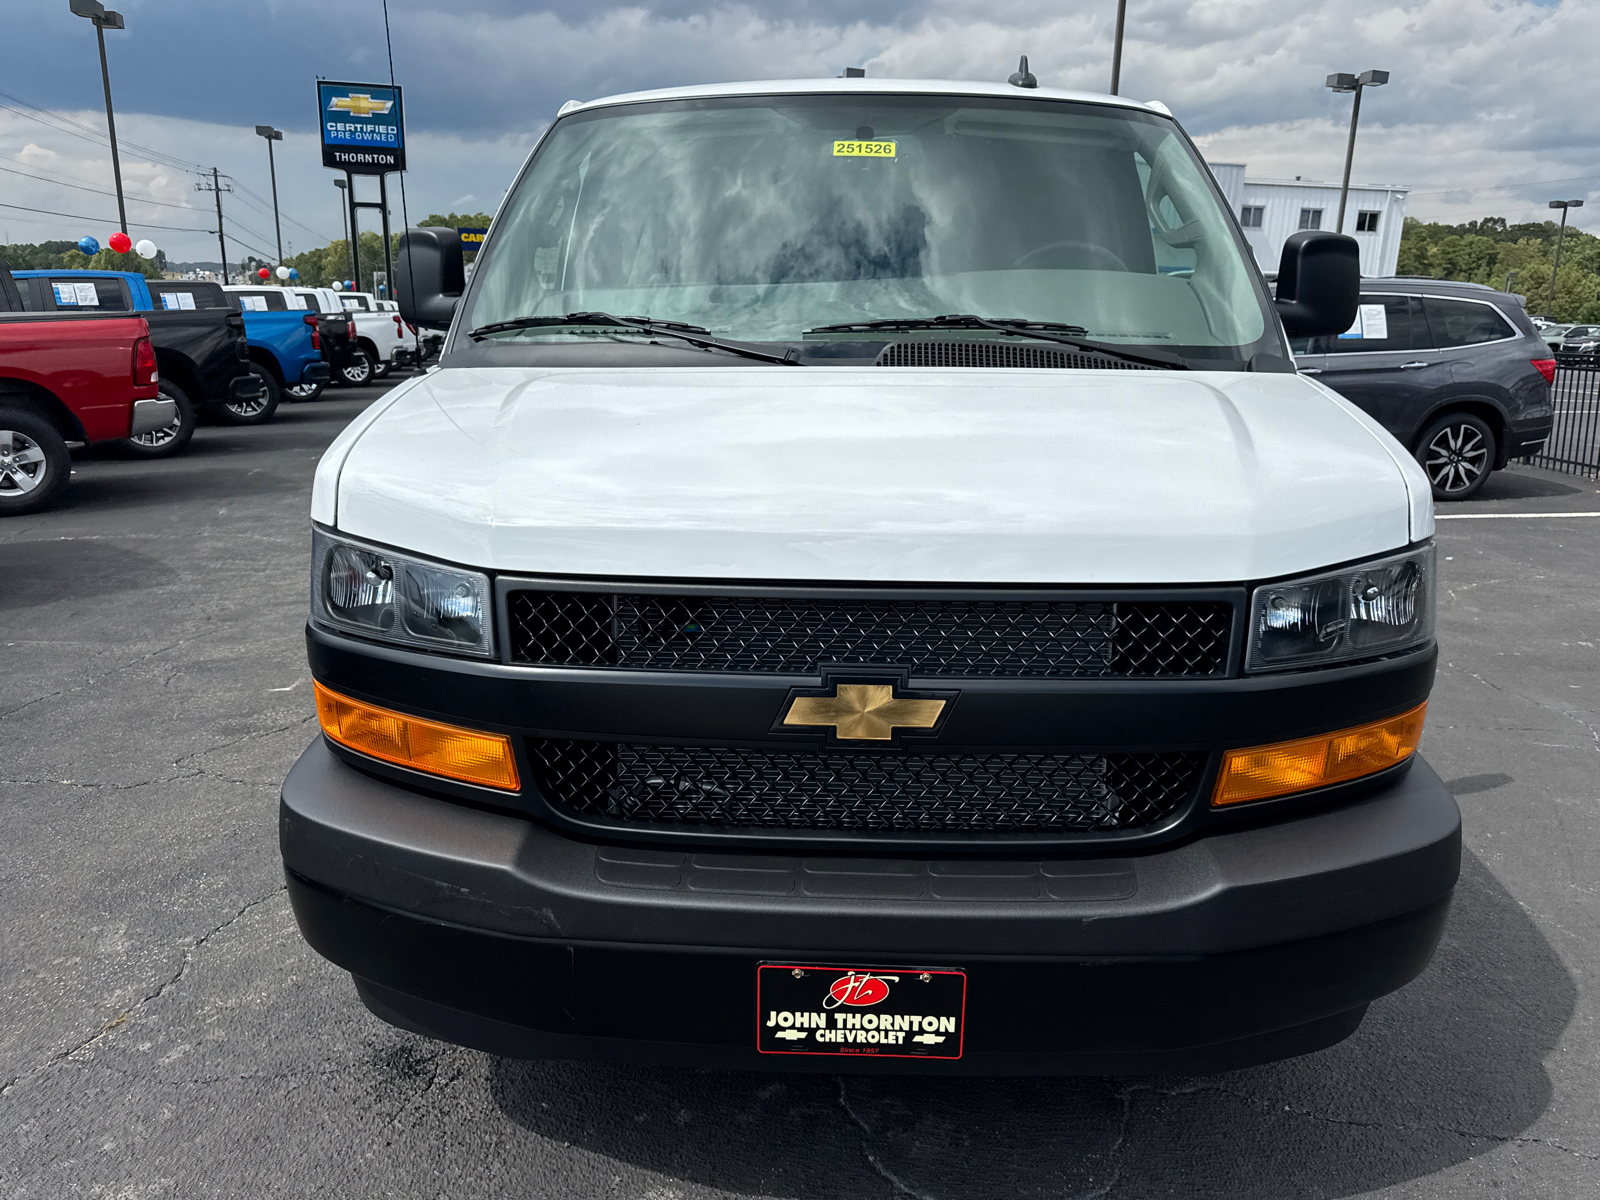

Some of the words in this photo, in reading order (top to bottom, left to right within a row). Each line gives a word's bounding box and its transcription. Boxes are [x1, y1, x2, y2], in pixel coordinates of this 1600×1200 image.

[326, 122, 397, 134] CERTIFIED
[330, 131, 395, 142] PRE-OWNED
[836, 143, 892, 154] 251526
[334, 152, 395, 164] THORNTON
[766, 1011, 826, 1028] JOHN
[834, 1013, 956, 1033] THORNTON
[815, 1029, 905, 1045] CHEVROLET
